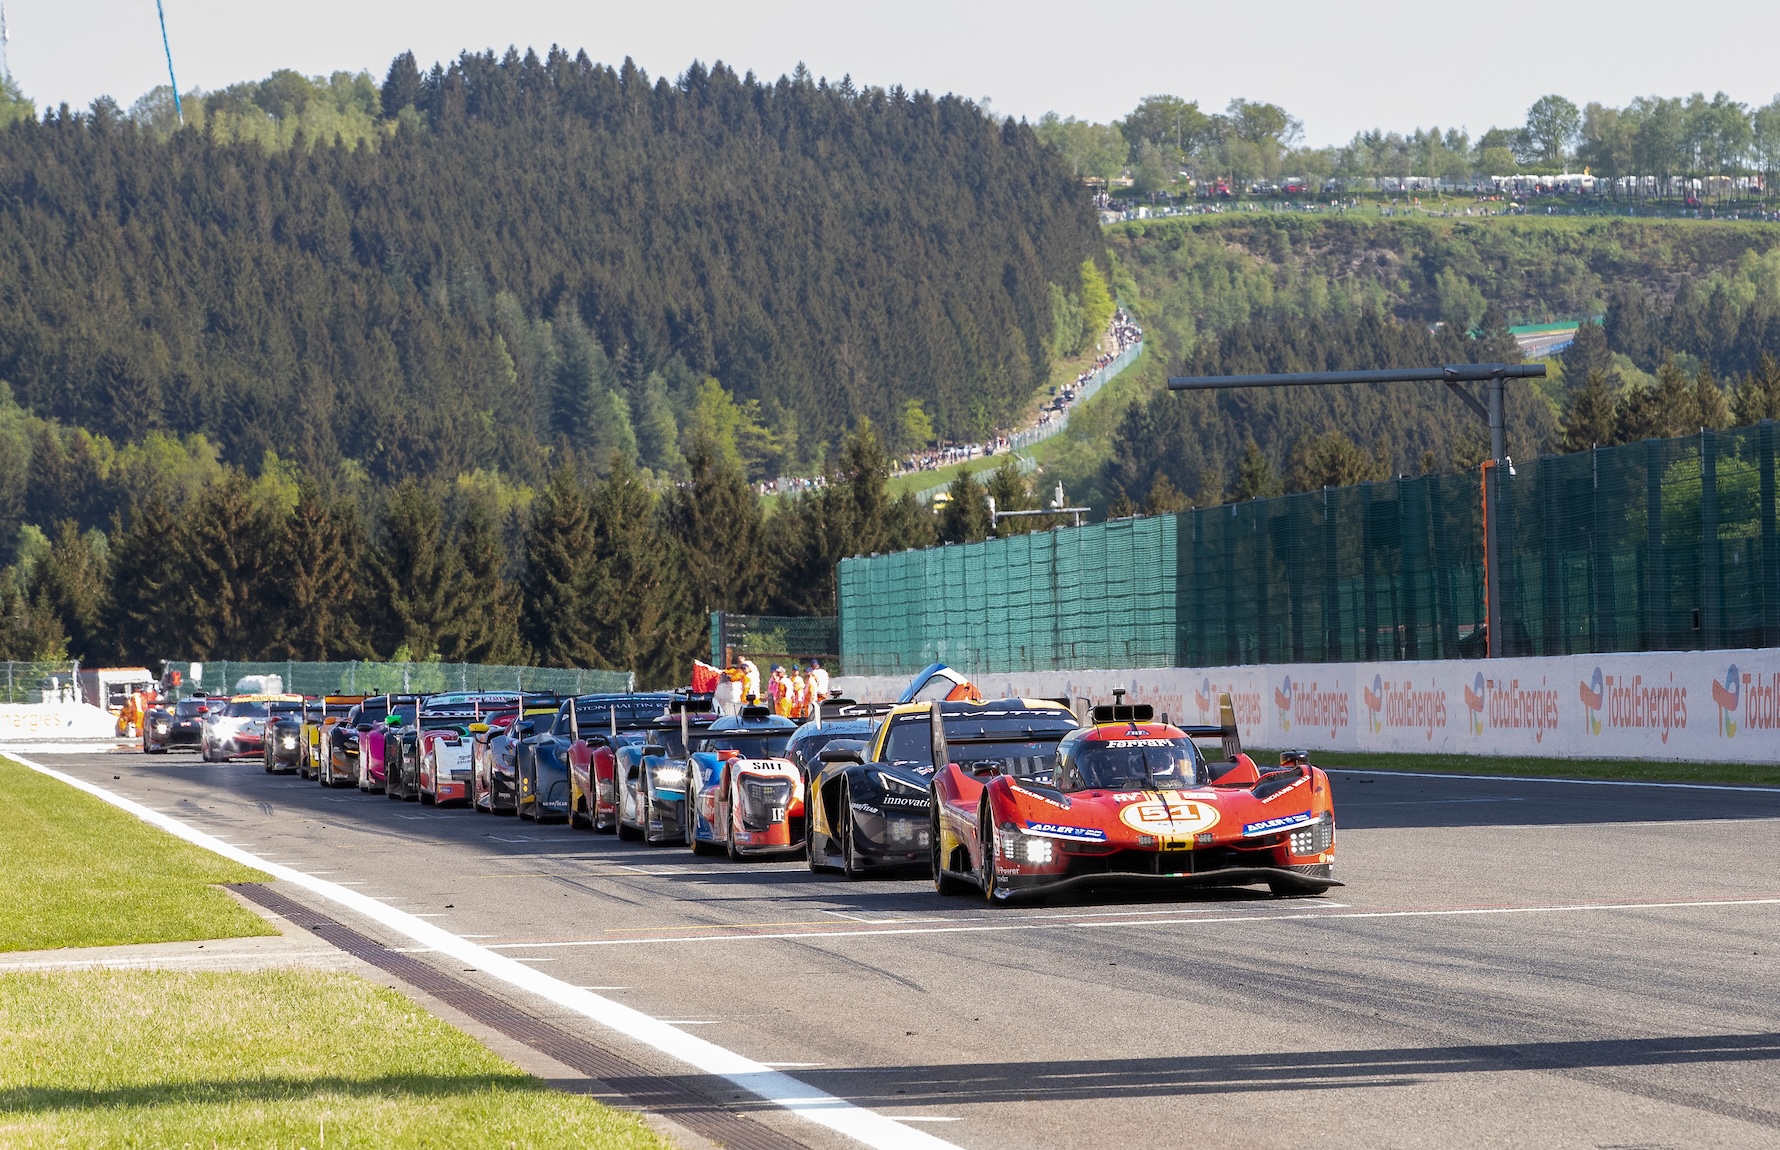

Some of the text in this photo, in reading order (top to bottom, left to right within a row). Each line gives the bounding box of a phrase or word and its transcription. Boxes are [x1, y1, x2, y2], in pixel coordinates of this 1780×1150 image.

[576, 703, 607, 713] STON
[1293, 679, 1348, 739] TotalEnergies
[1384, 677, 1447, 741] TotalEnergies
[1486, 675, 1559, 744] TotalEnergies
[1606, 671, 1688, 744] TotalEnergies
[1106, 739, 1175, 749] Ferrari
[1009, 785, 1045, 801] RICHARD
[1139, 804, 1200, 821] 51
[1030, 823, 1074, 834] ADLER
[1247, 818, 1288, 832] ADLER
